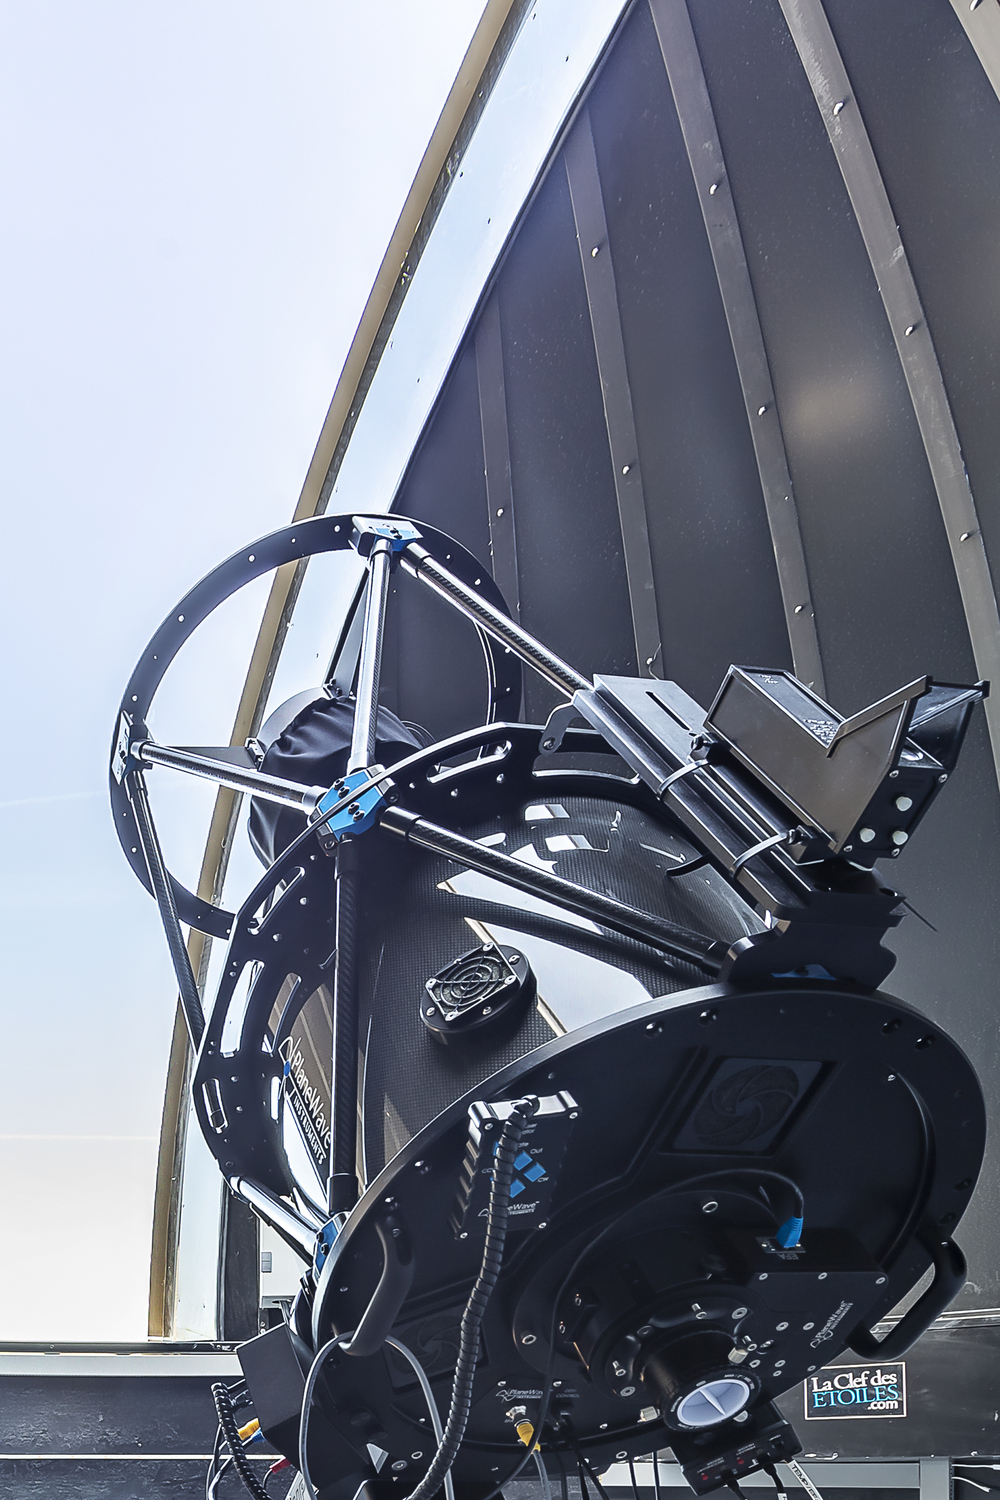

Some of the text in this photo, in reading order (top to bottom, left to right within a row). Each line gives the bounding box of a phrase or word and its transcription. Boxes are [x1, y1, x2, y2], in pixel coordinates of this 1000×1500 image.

[291, 1050, 332, 1149] PlaneWave
[293, 1095, 325, 1165] INSTRUMENTS
[529, 1147, 544, 1155] Out
[811, 1369, 898, 1392] La Clef des
[812, 1384, 899, 1408] ETOILES
[867, 1400, 899, 1410] .com
